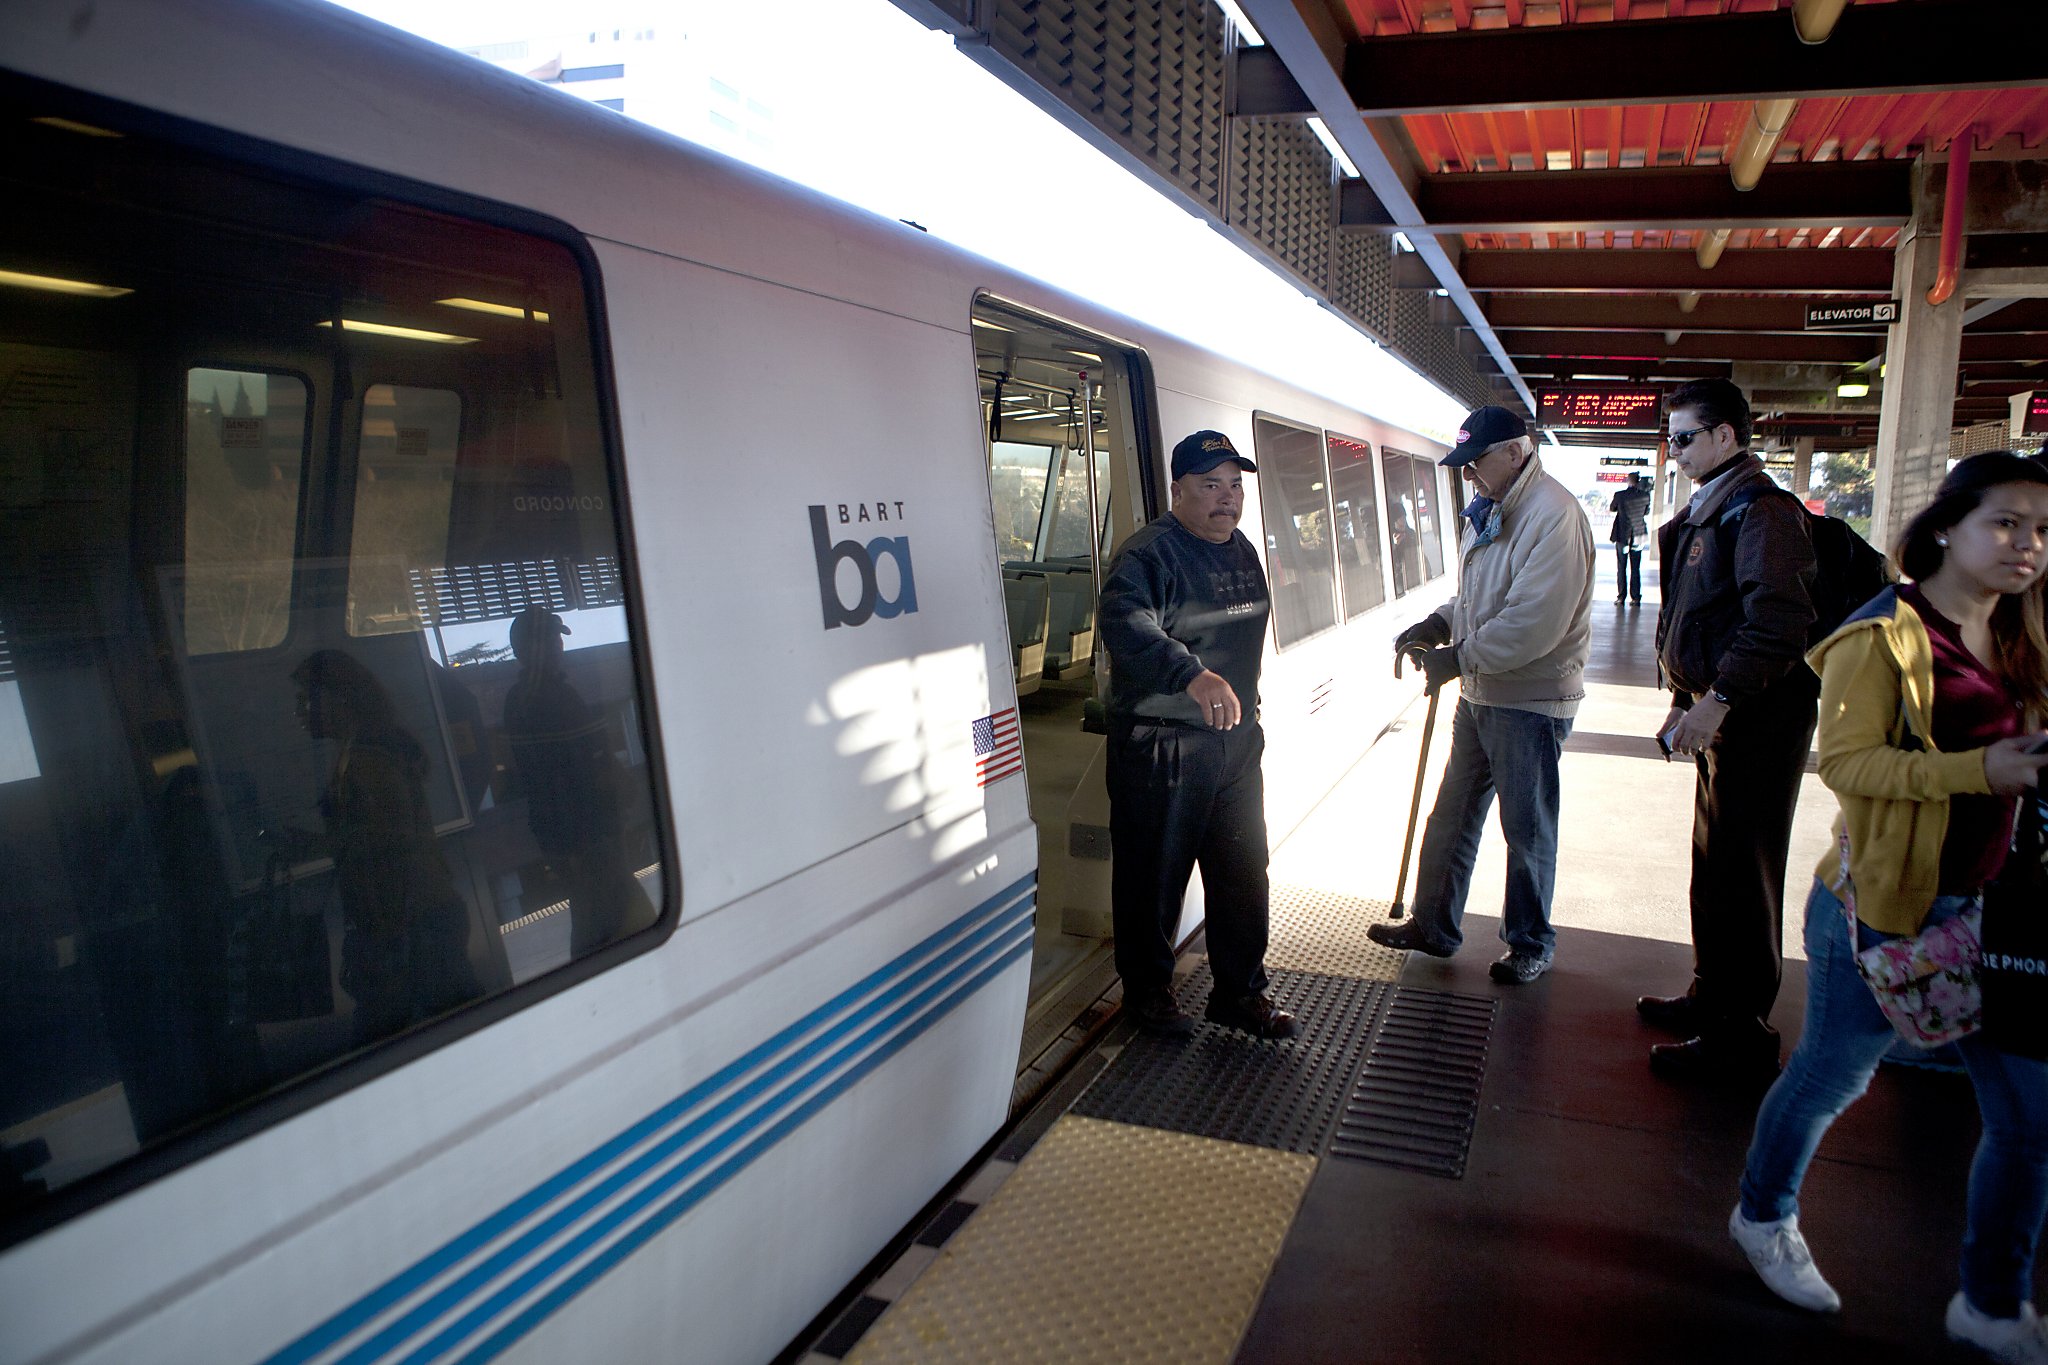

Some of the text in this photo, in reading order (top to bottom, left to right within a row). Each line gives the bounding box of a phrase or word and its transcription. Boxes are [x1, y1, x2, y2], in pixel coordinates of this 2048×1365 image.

[1810, 308, 1871, 321] ELEVATOR
[838, 501, 905, 524] BART
[808, 505, 918, 631] ba
[1982, 951, 2048, 976] SEPHOR
